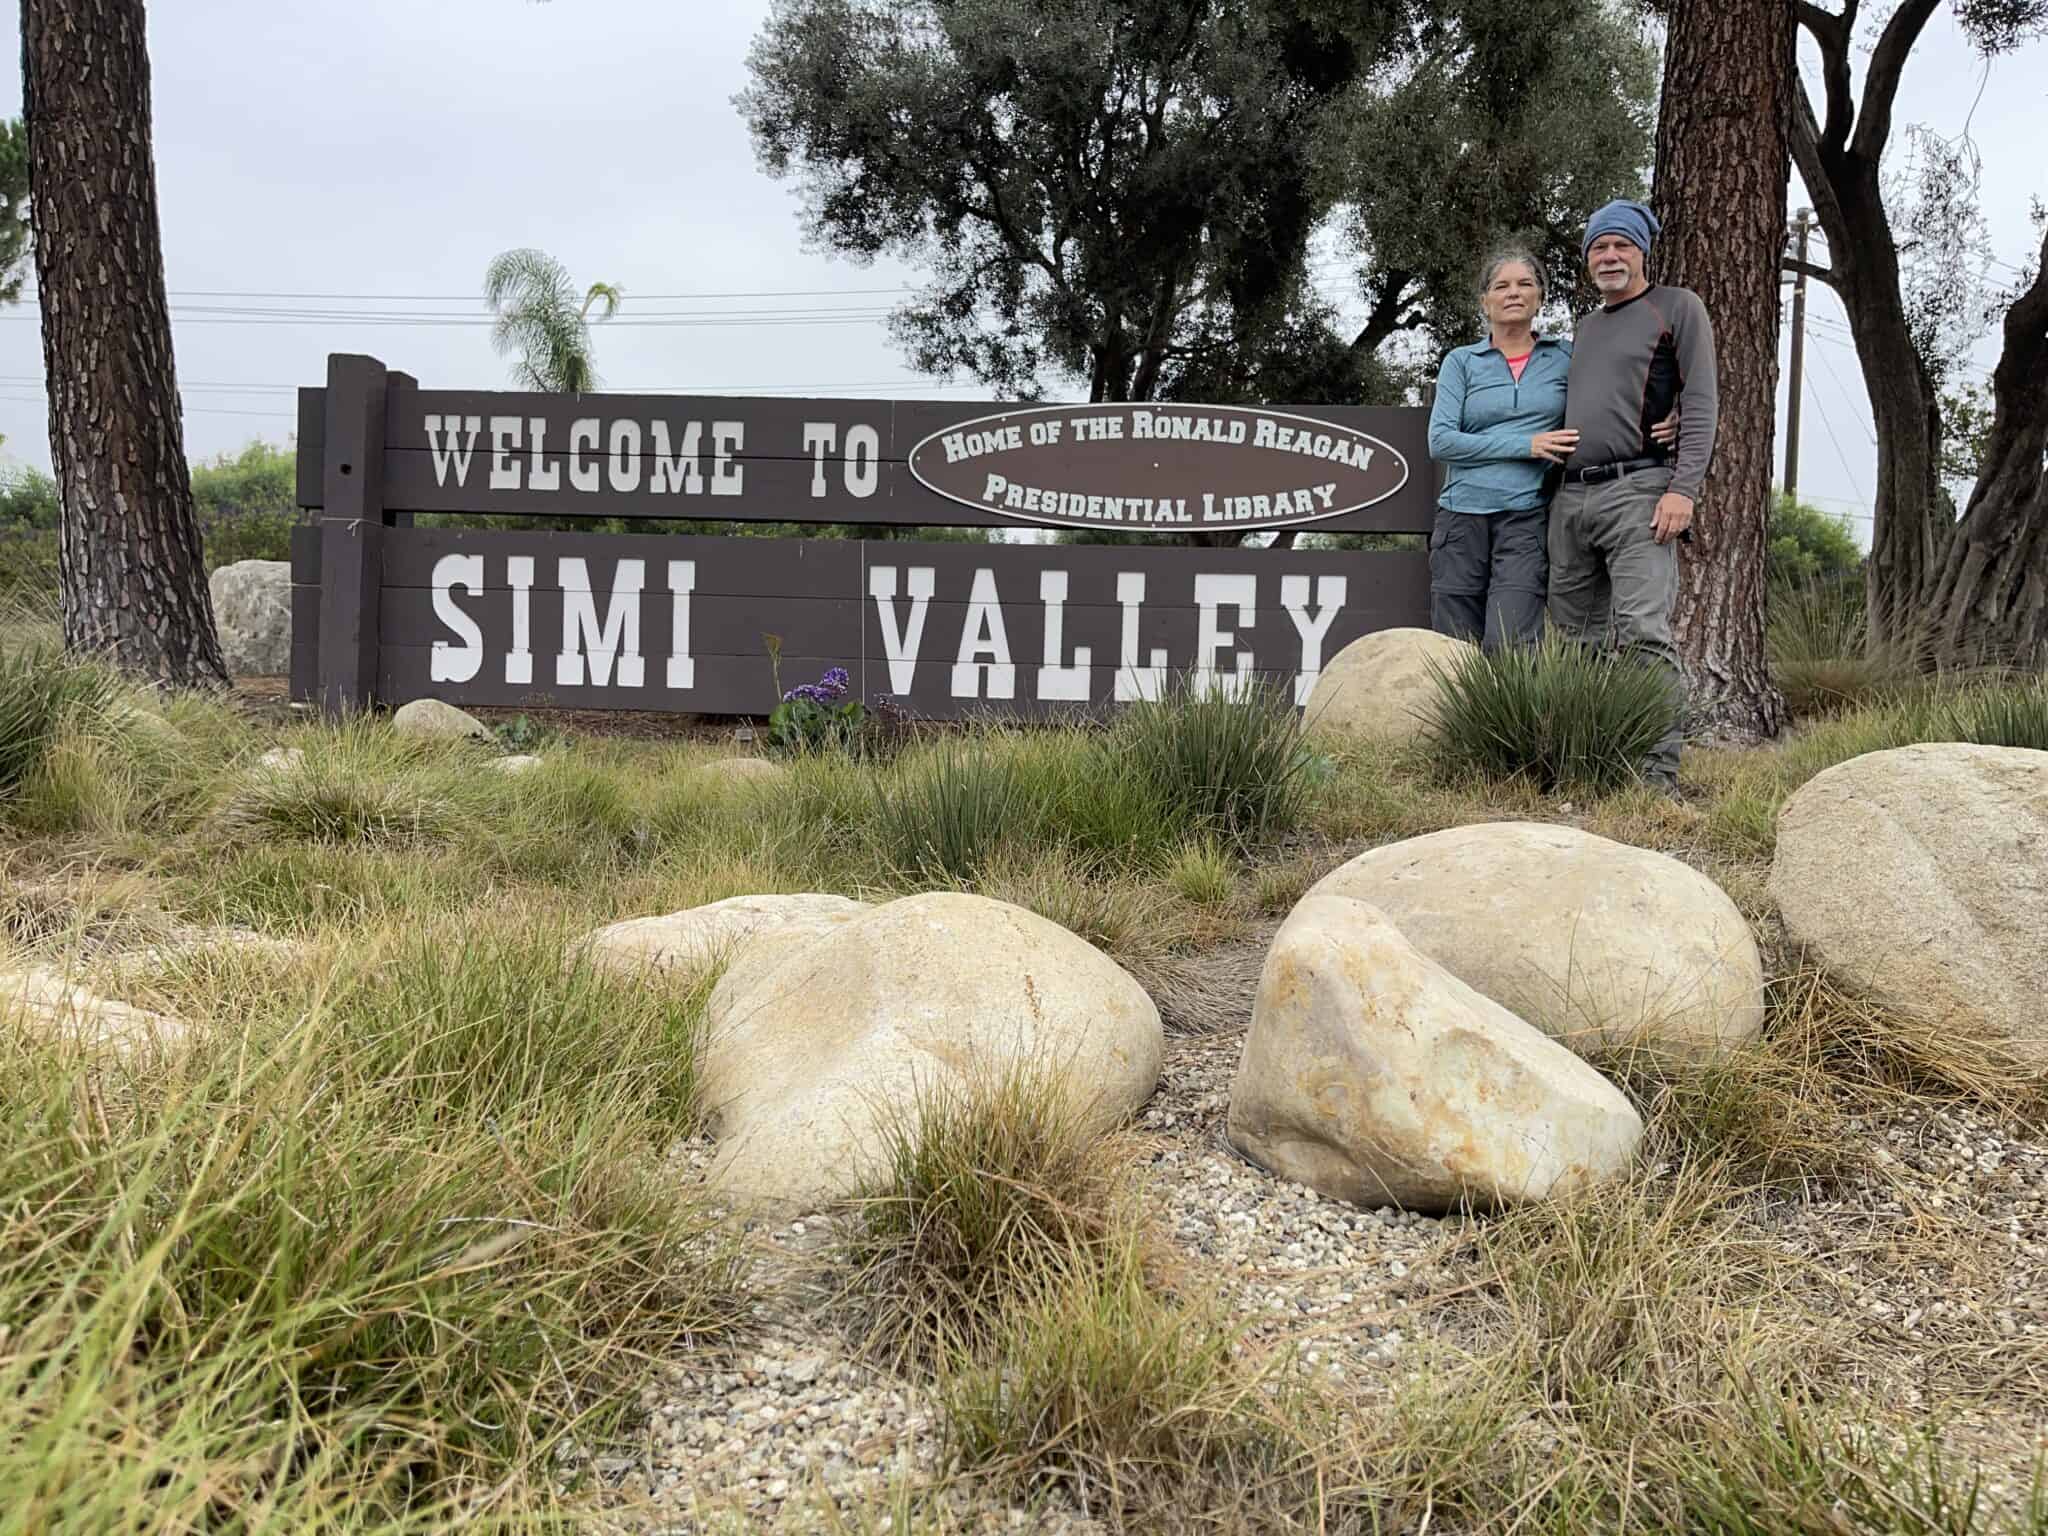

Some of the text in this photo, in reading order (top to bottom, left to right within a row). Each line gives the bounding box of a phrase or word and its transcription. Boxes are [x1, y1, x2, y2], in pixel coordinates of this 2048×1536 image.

[424, 414, 880, 498] WELCOME TO
[941, 410, 1376, 471] HOME OF THE RONALD REAGAN
[982, 473, 1337, 522] PRESIDENTIAL LIBRARY
[430, 553, 1348, 706] SIMI VALLEY
